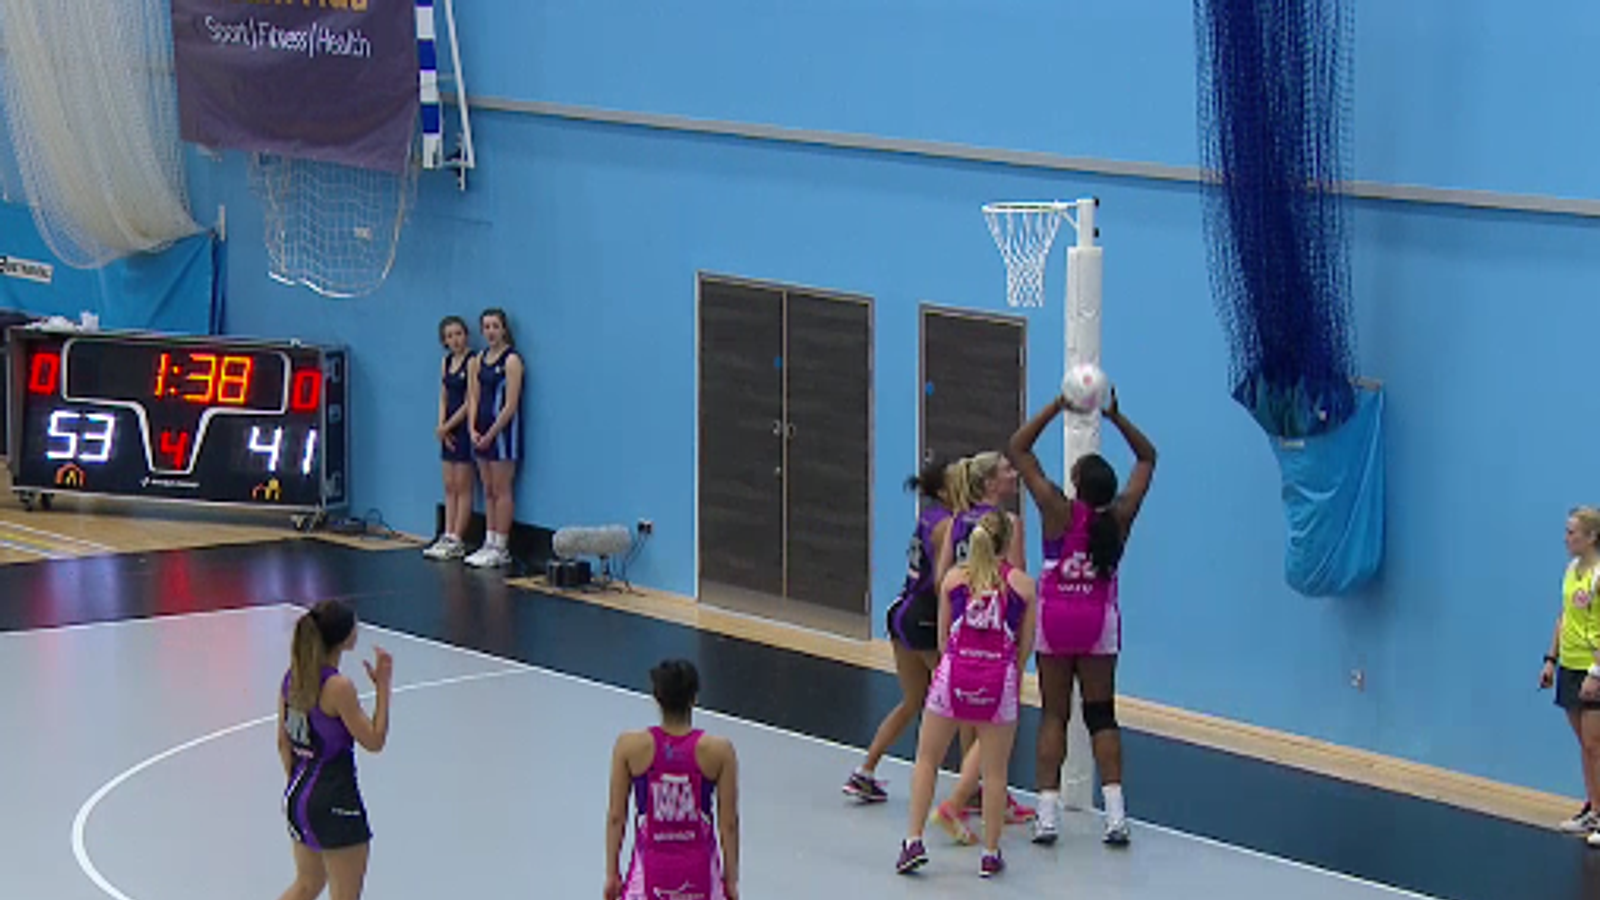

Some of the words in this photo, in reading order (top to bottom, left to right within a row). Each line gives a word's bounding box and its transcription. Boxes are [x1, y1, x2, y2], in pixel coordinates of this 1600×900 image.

[28, 352, 60, 394] 0
[154, 352, 253, 404] 1:38
[291, 368, 322, 413] 0
[46, 409, 115, 462] 53
[159, 430, 188, 470] 4
[249, 426, 317, 475] 41
